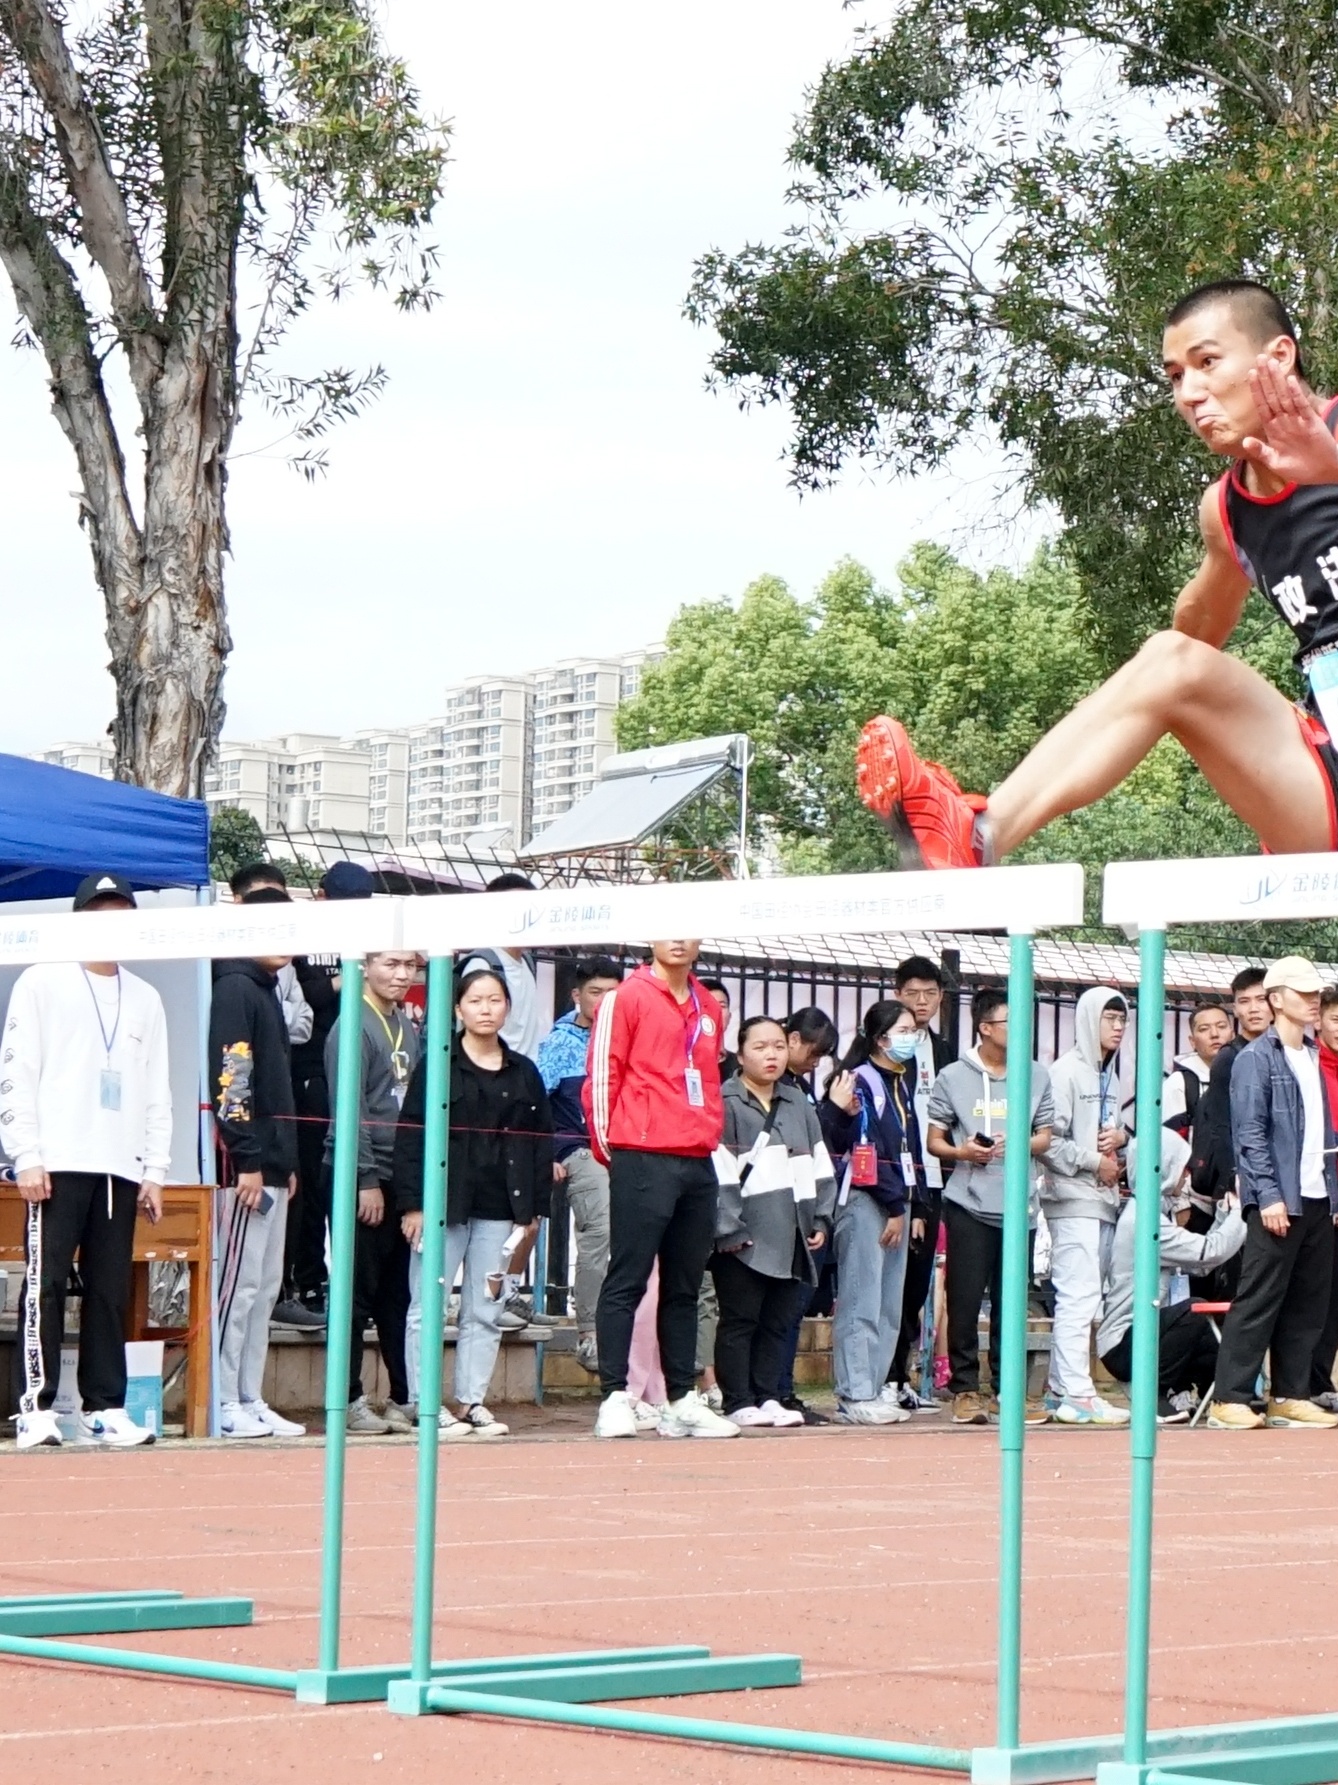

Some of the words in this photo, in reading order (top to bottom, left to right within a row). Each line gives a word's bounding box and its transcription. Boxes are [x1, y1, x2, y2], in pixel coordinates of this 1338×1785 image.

[549, 904, 611, 924] 金陵体育
[0, 929, 39, 945] 陵体育
